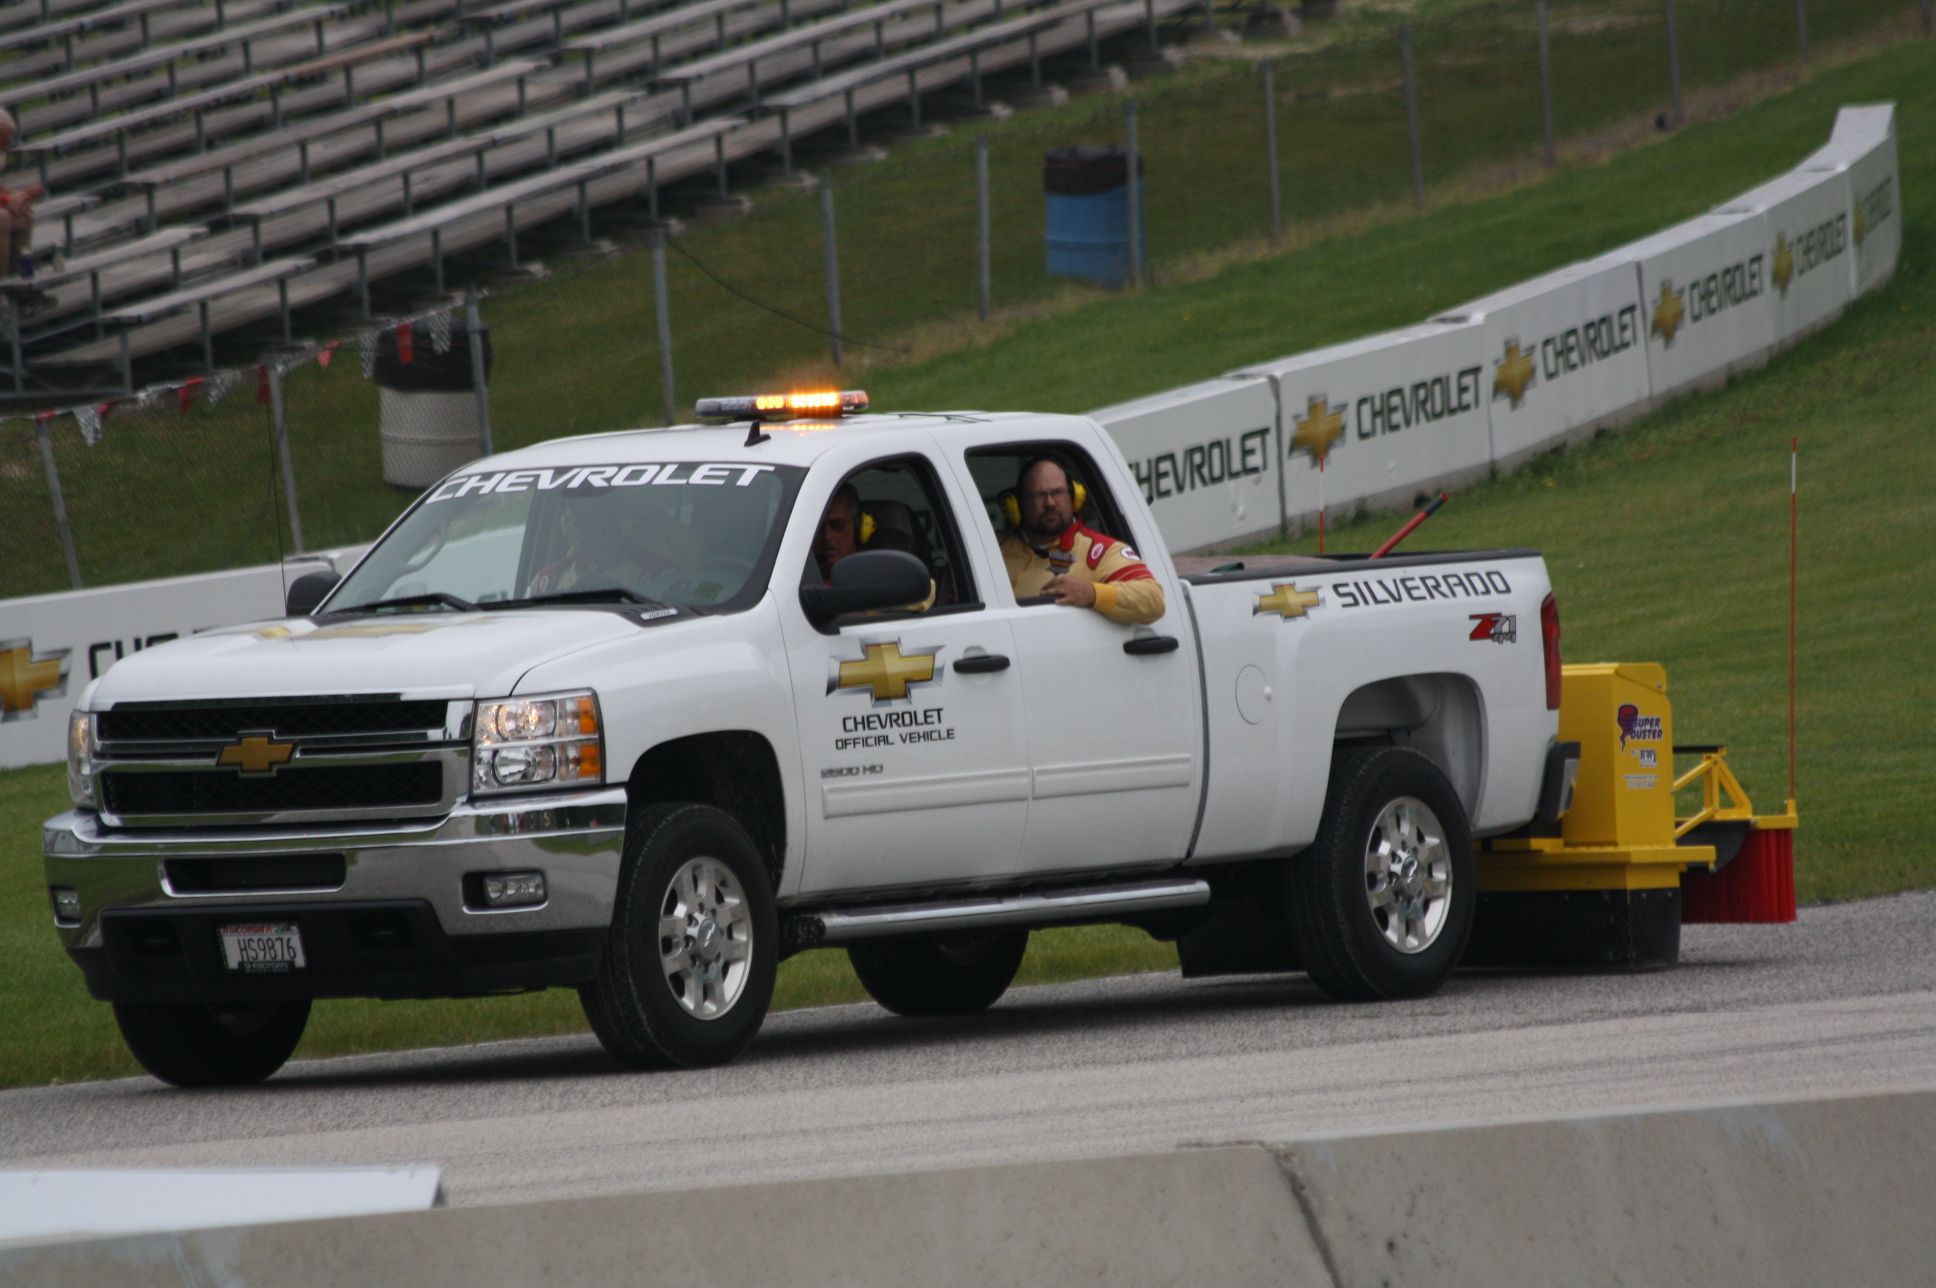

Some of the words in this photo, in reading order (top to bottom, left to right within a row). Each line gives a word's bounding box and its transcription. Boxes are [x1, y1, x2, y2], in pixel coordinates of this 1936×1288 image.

[1689, 254, 1763, 323] CHEVROLET
[1541, 304, 1638, 380] CHEVROLET
[1356, 366, 1482, 441] CHEVROLET
[425, 463, 775, 504] CHEVROLET
[1128, 427, 1270, 502] HEVROLET
[1332, 570, 1512, 608] SILVERADO
[1469, 612, 1516, 641] Z71
[835, 732, 894, 750] OFFICIAL
[899, 728, 955, 745] VEHICLE
[842, 708, 944, 733] CHEVROLET
[1633, 717, 1661, 729] SUPER
[237, 937, 297, 963] HS9876
